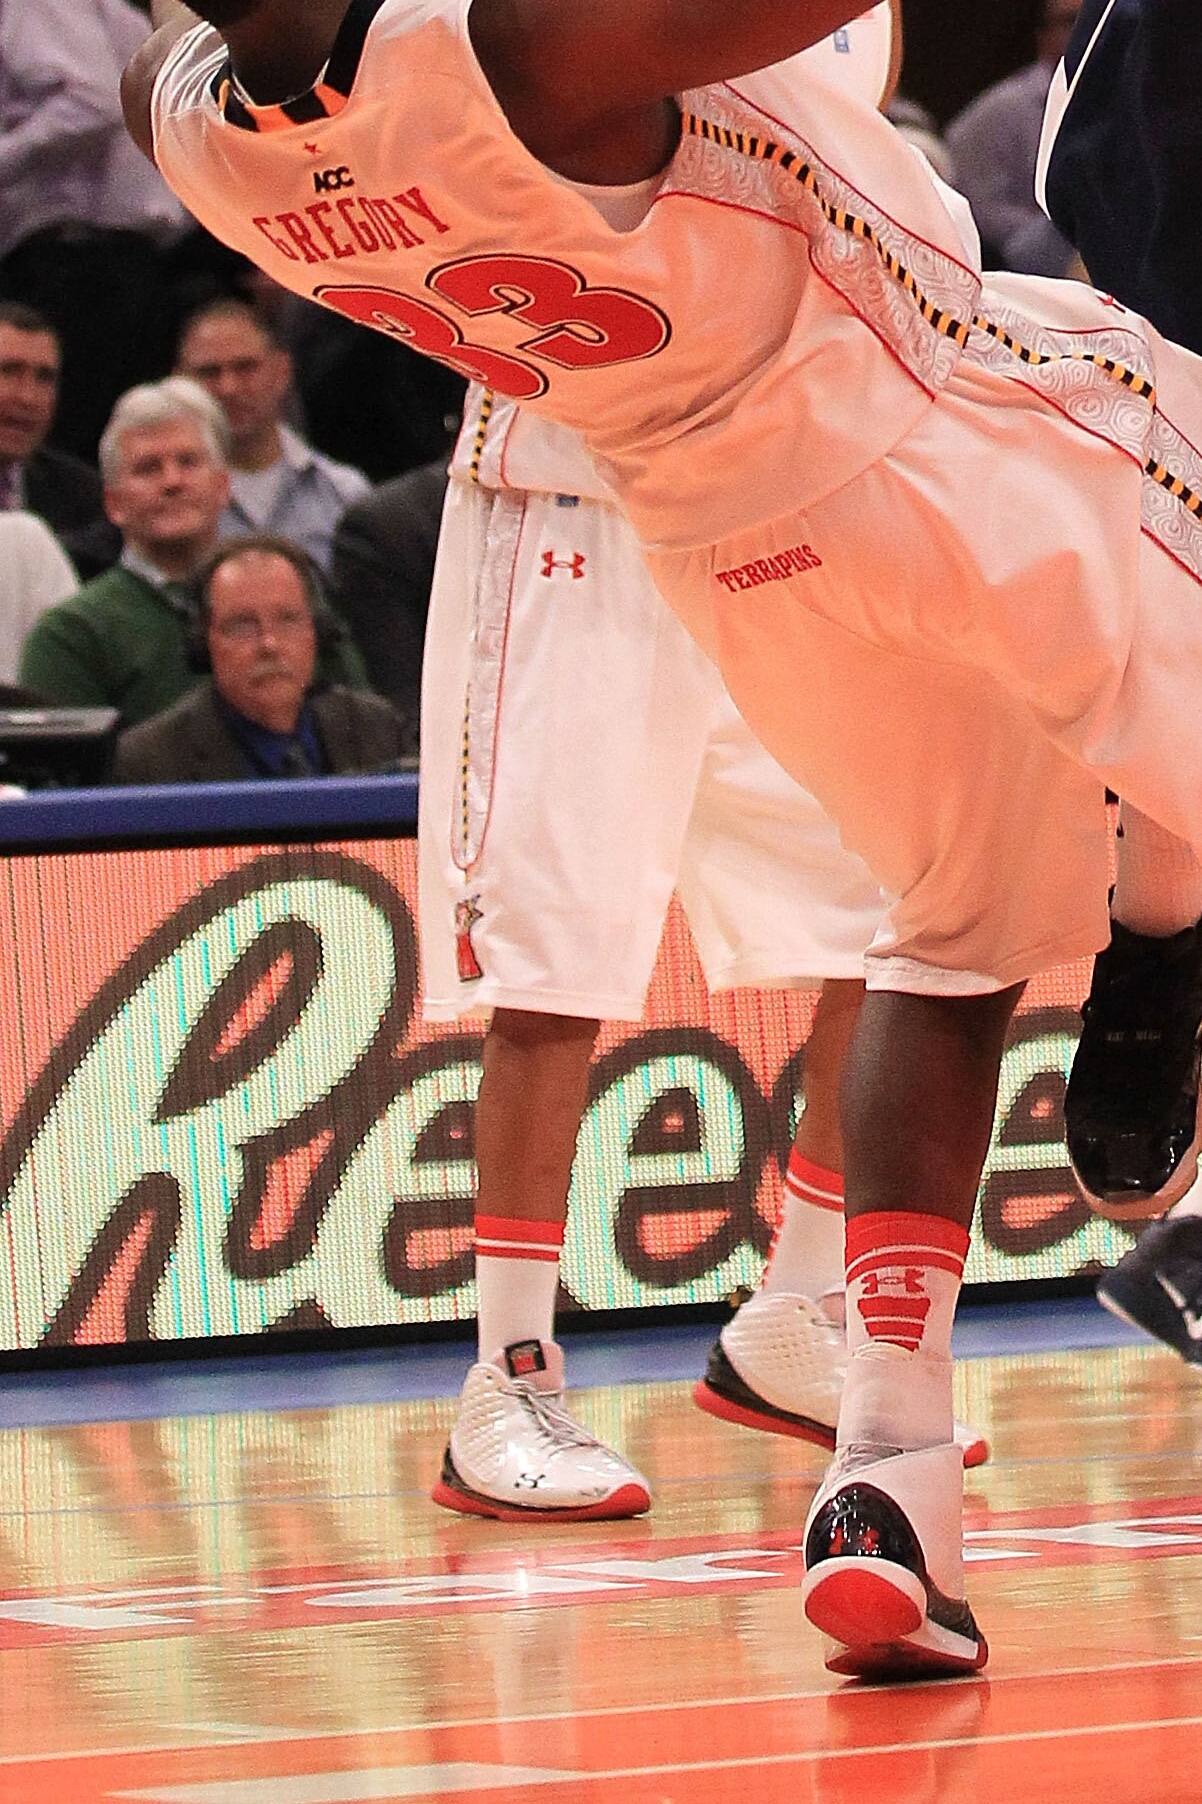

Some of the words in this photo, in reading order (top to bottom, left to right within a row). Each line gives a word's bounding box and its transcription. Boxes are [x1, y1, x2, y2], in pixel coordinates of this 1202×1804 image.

[313, 165, 355, 193] ACC
[252, 186, 450, 264] GREGORY
[312, 252, 672, 400] 33
[715, 543, 823, 593] TERRAPINS
